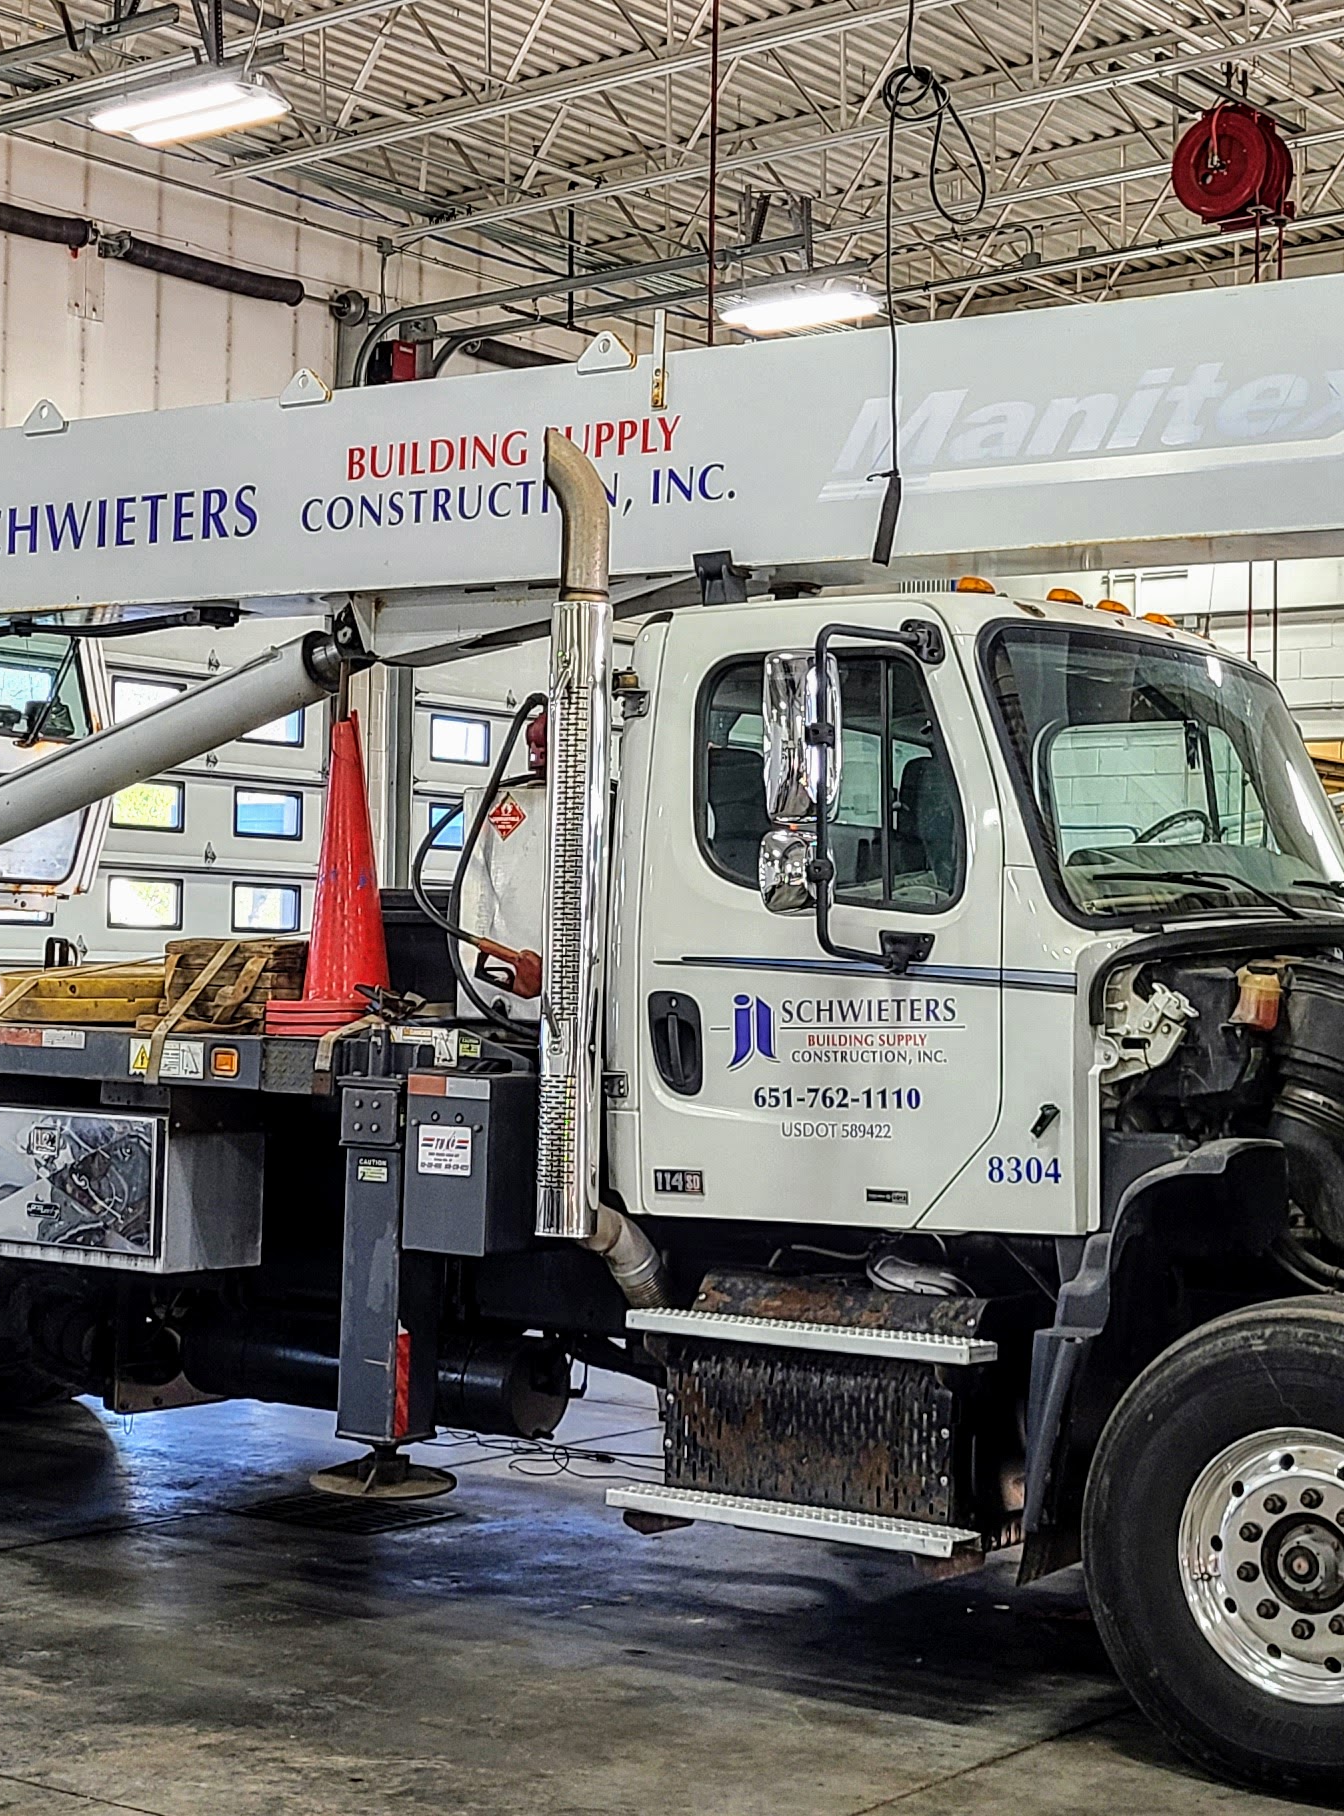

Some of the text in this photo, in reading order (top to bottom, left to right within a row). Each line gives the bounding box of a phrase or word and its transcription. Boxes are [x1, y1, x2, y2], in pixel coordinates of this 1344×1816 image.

[347, 415, 681, 481] BUILDING UPPLY
[302, 464, 736, 533] CONSTRUCTIN, INC.
[781, 997, 957, 1024] SCHWIETERS
[807, 1034, 927, 1047] BUILDING SUPPLY
[791, 1050, 948, 1065] CONSTRUCTION, INC.
[754, 1086, 922, 1110] 651-762-1110
[781, 1122, 892, 1139] USDOT 589422
[359, 1158, 387, 1166] CAUTION
[988, 1156, 1063, 1184] 8304
[656, 1171, 683, 1191] 114
